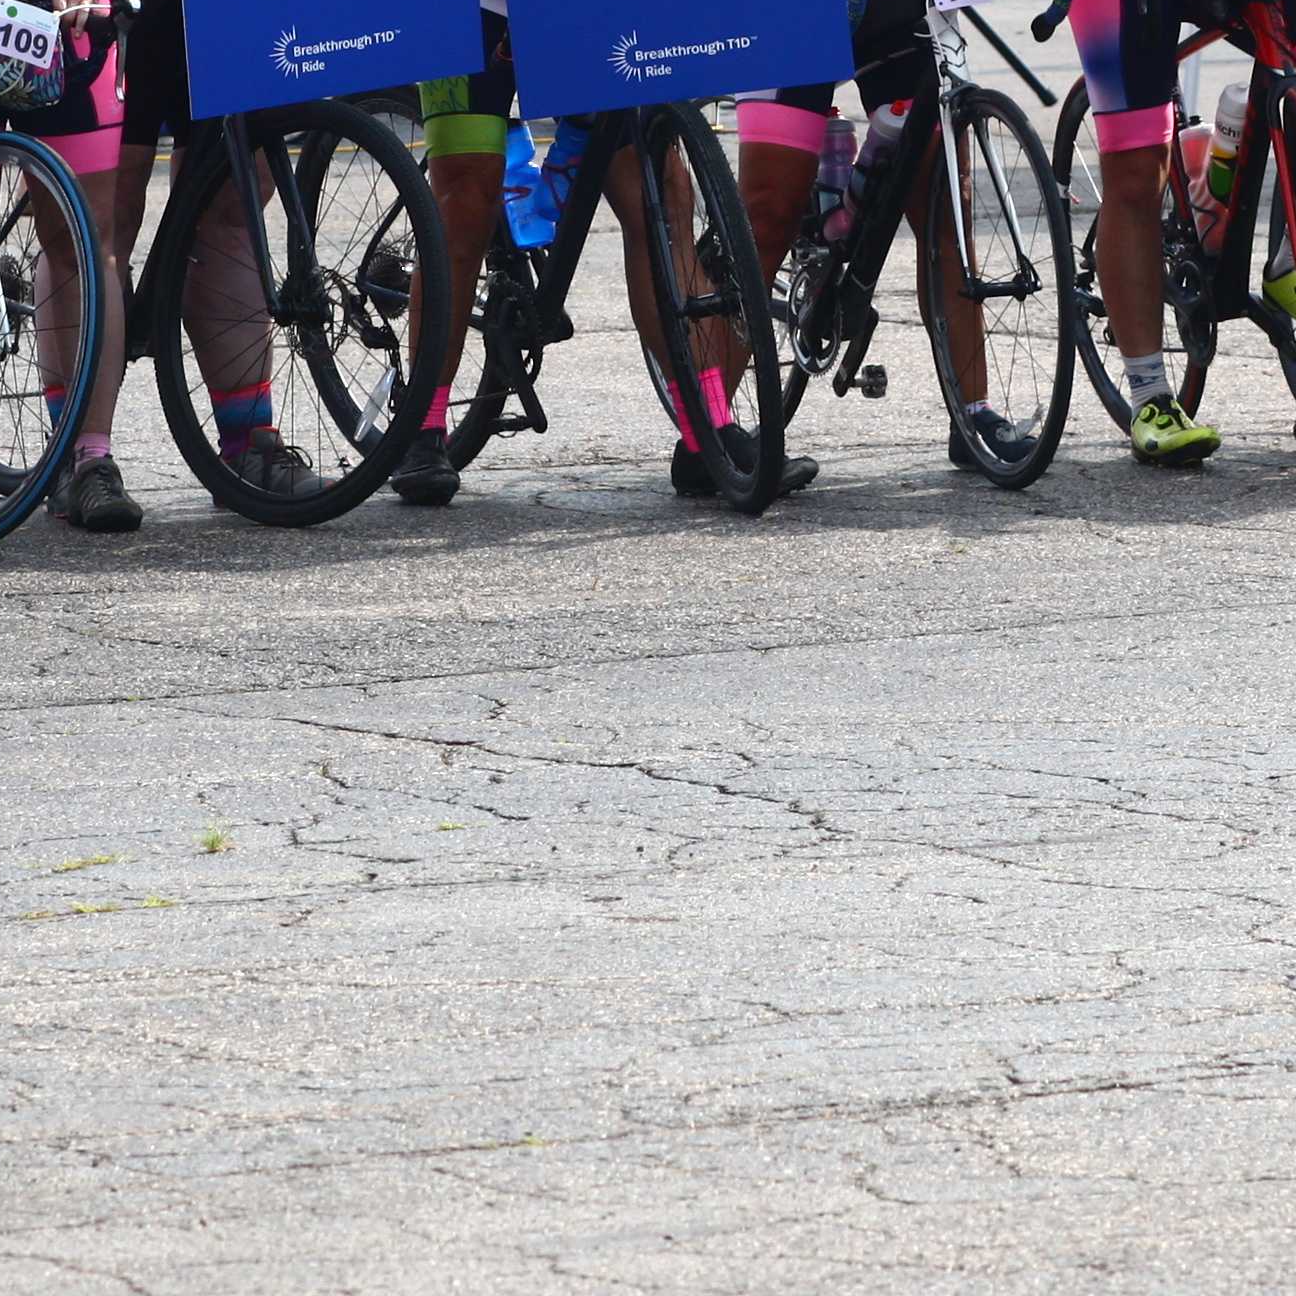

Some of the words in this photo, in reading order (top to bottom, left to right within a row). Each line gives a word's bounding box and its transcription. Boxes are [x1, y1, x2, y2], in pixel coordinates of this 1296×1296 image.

[294, 35, 372, 57] Breakthrough
[635, 41, 724, 61] Breakthrough
[302, 60, 325, 72] Ride
[646, 65, 671, 77] Ride
